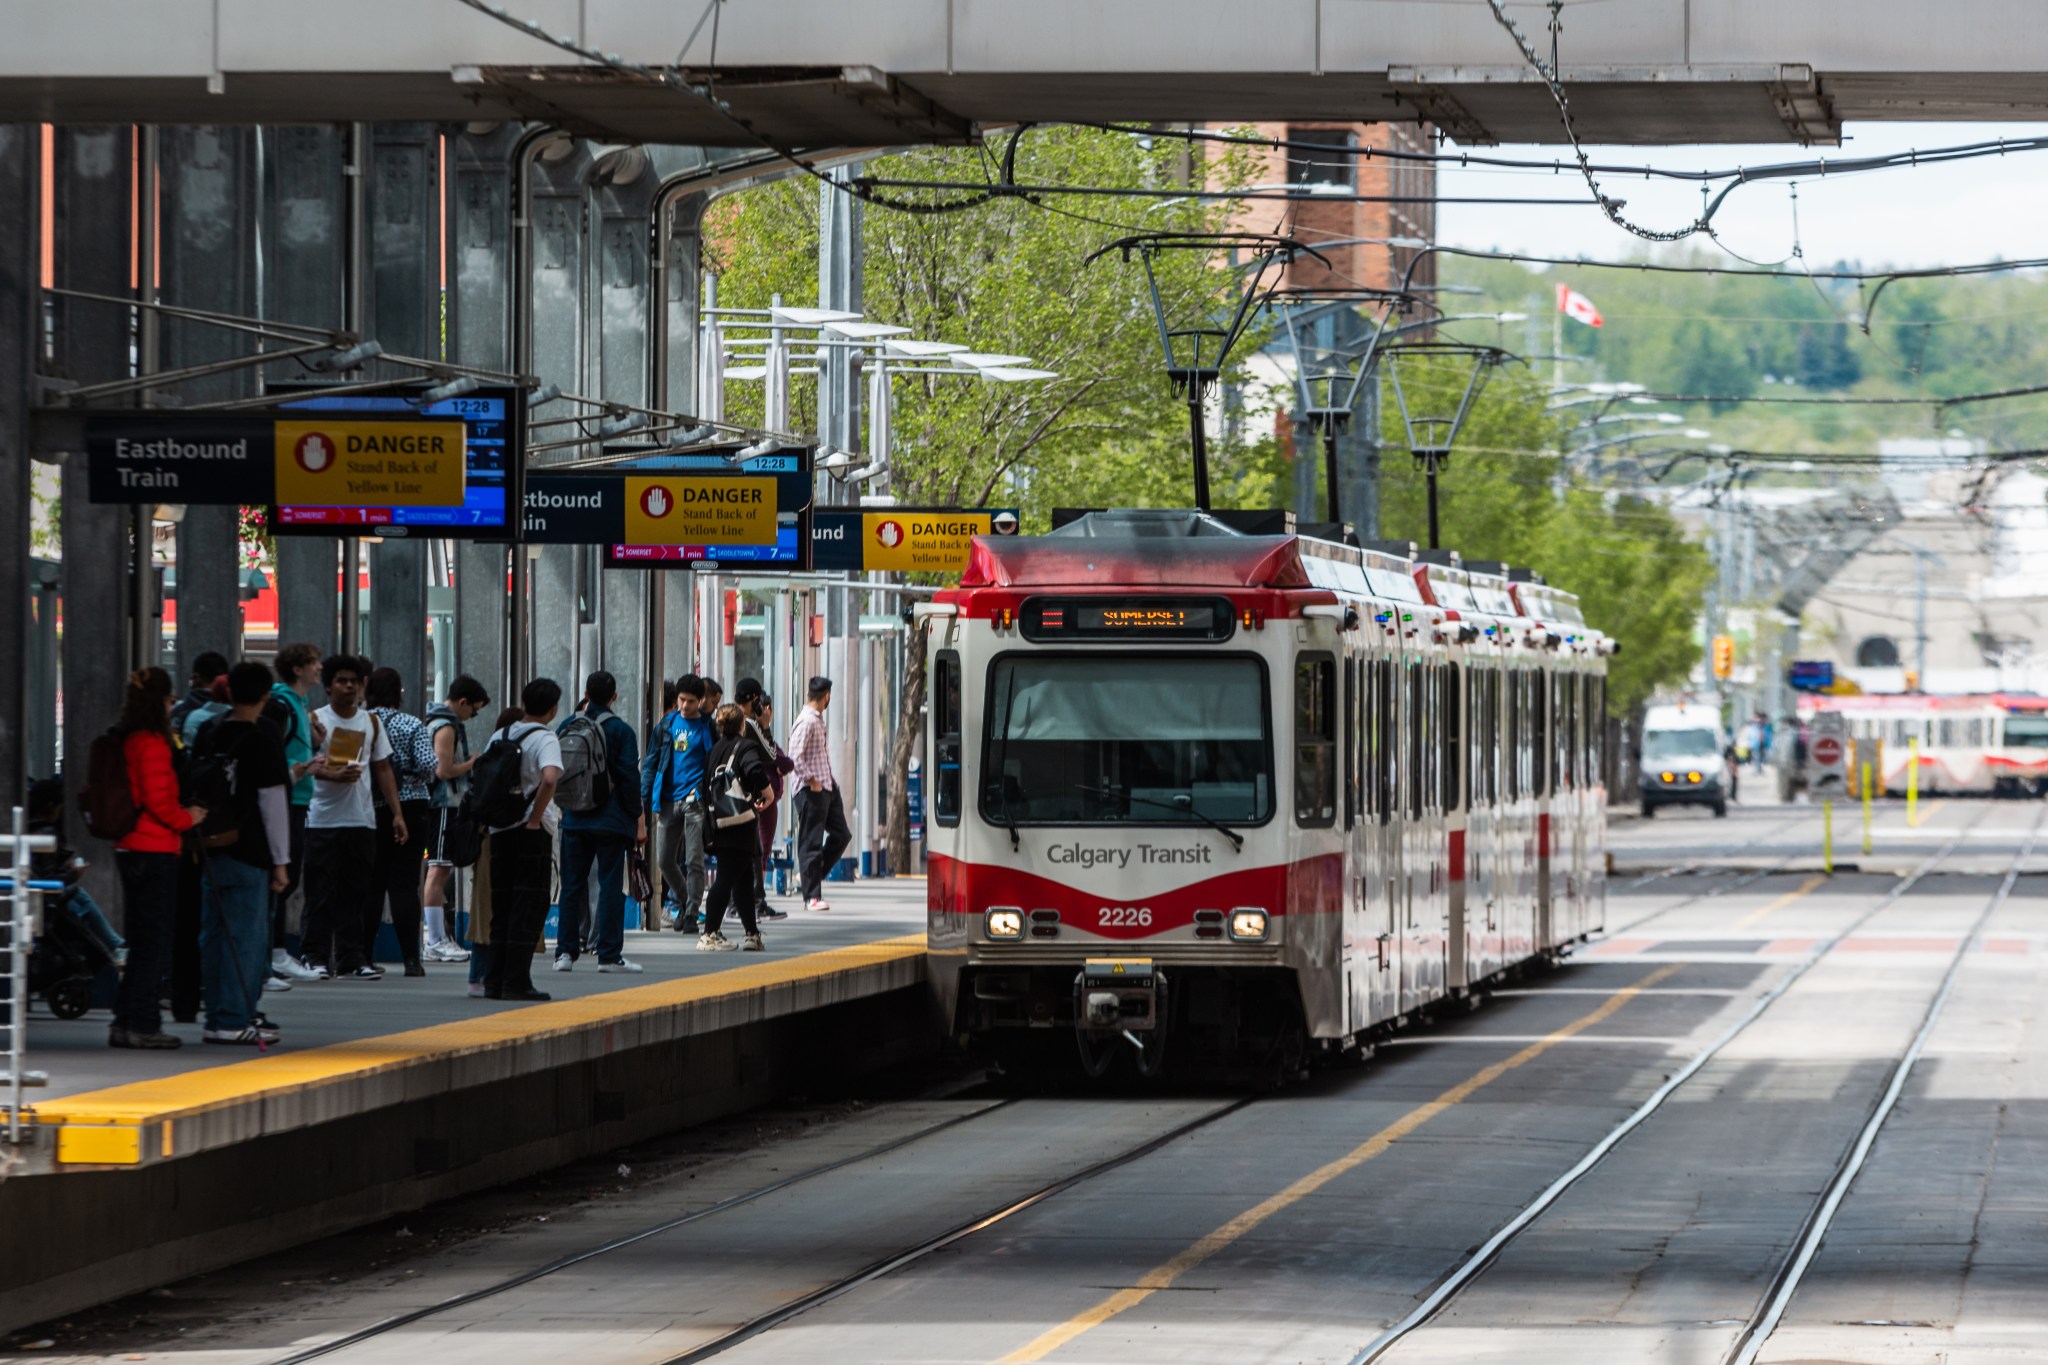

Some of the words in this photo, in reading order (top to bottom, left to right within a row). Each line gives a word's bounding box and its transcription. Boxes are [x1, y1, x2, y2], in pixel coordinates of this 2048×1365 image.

[452, 400, 491, 413] 12:28
[477, 428, 488, 436] 17
[115, 437, 247, 460] Eastbound
[347, 435, 444, 454] DANGER
[346, 460, 384, 474] Stand
[388, 460, 420, 474] Back
[424, 461, 439, 474] of
[754, 458, 786, 469] 12:28
[116, 467, 179, 487] Train
[346, 480, 389, 494] Yellow
[394, 482, 423, 495] Line
[523, 491, 602, 508] stbound
[683, 488, 763, 504] DANGER
[359, 509, 367, 522] 1
[370, 514, 388, 522] min
[472, 510, 481, 523] 7
[683, 508, 713, 520] Stand
[716, 508, 743, 520] Back
[746, 508, 758, 520] of
[683, 524, 717, 536] Yellow
[721, 524, 745, 536] Line
[911, 523, 978, 536] DANGER
[911, 540, 937, 550] Stand
[939, 540, 963, 550] Back
[964, 542, 971, 550] o
[625, 549, 652, 557] SOMERSET
[678, 547, 685, 558] 1
[717, 549, 754, 557] SADDLETOWNE
[770, 547, 778, 558] 7
[911, 554, 940, 564] Yellow
[943, 553, 963, 563] Line
[1046, 842, 1132, 869] Calgary
[1137, 843, 1212, 864] Transit
[1098, 907, 1152, 927] 2226
